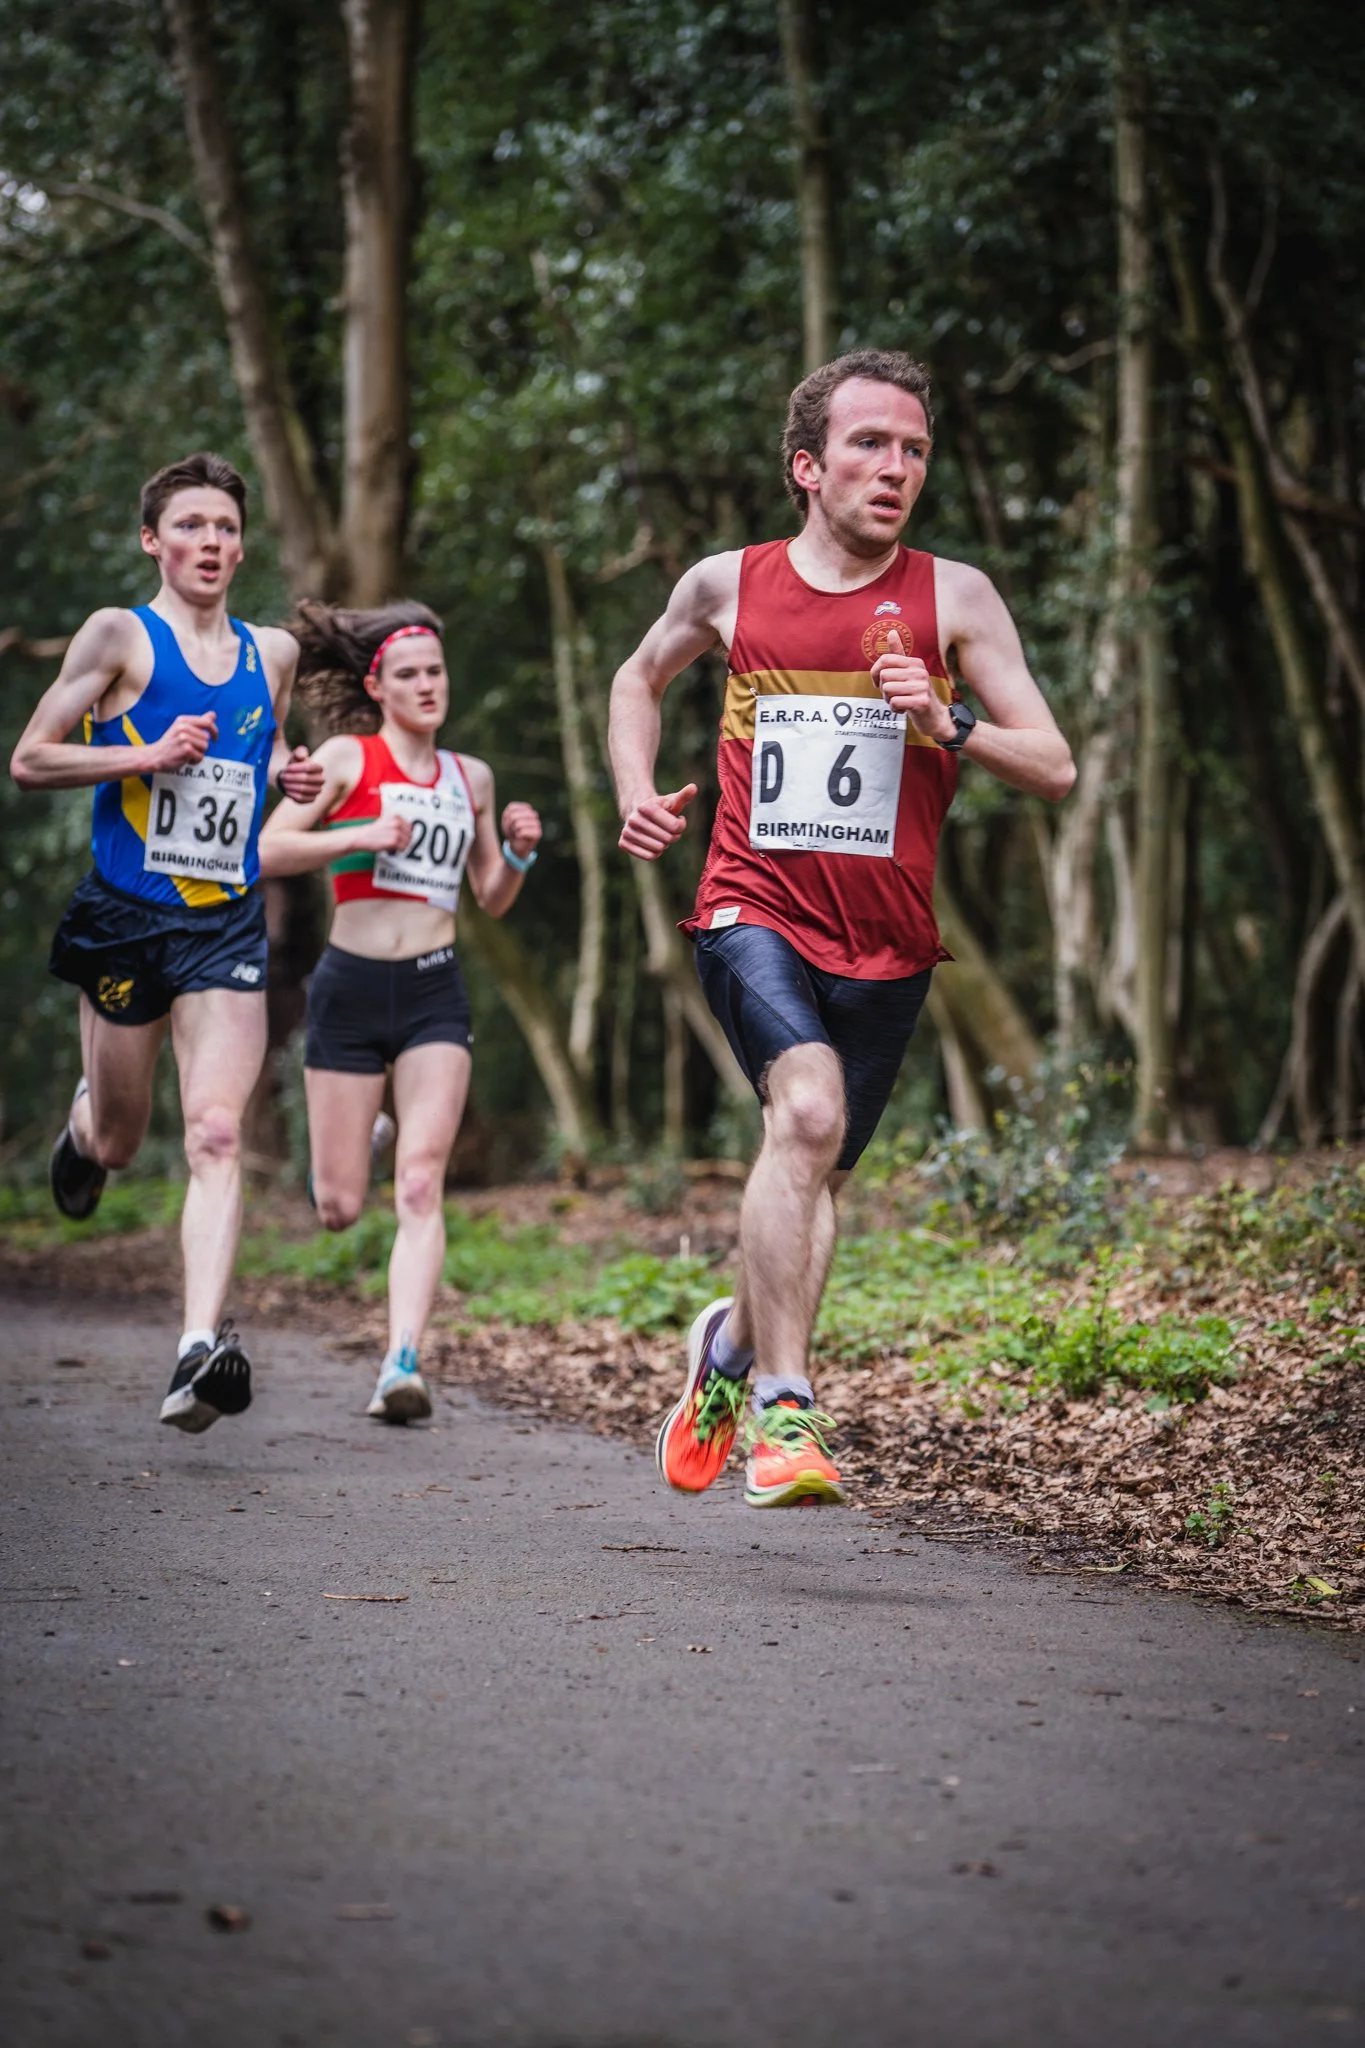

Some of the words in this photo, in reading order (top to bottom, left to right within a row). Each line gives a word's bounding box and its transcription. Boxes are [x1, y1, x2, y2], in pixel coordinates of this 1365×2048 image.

[760, 710, 828, 723] E.R.R.A.
[854, 707, 899, 722] START
[852, 720, 899, 731] FITNESS
[759, 741, 784, 804] D
[827, 744, 862, 807] 6
[155, 788, 177, 836] D
[193, 796, 238, 847] 36
[406, 818, 465, 869] 201
[756, 823, 890, 844] BIRMINGHAM
[151, 851, 239, 873] BIRMINGHAM
